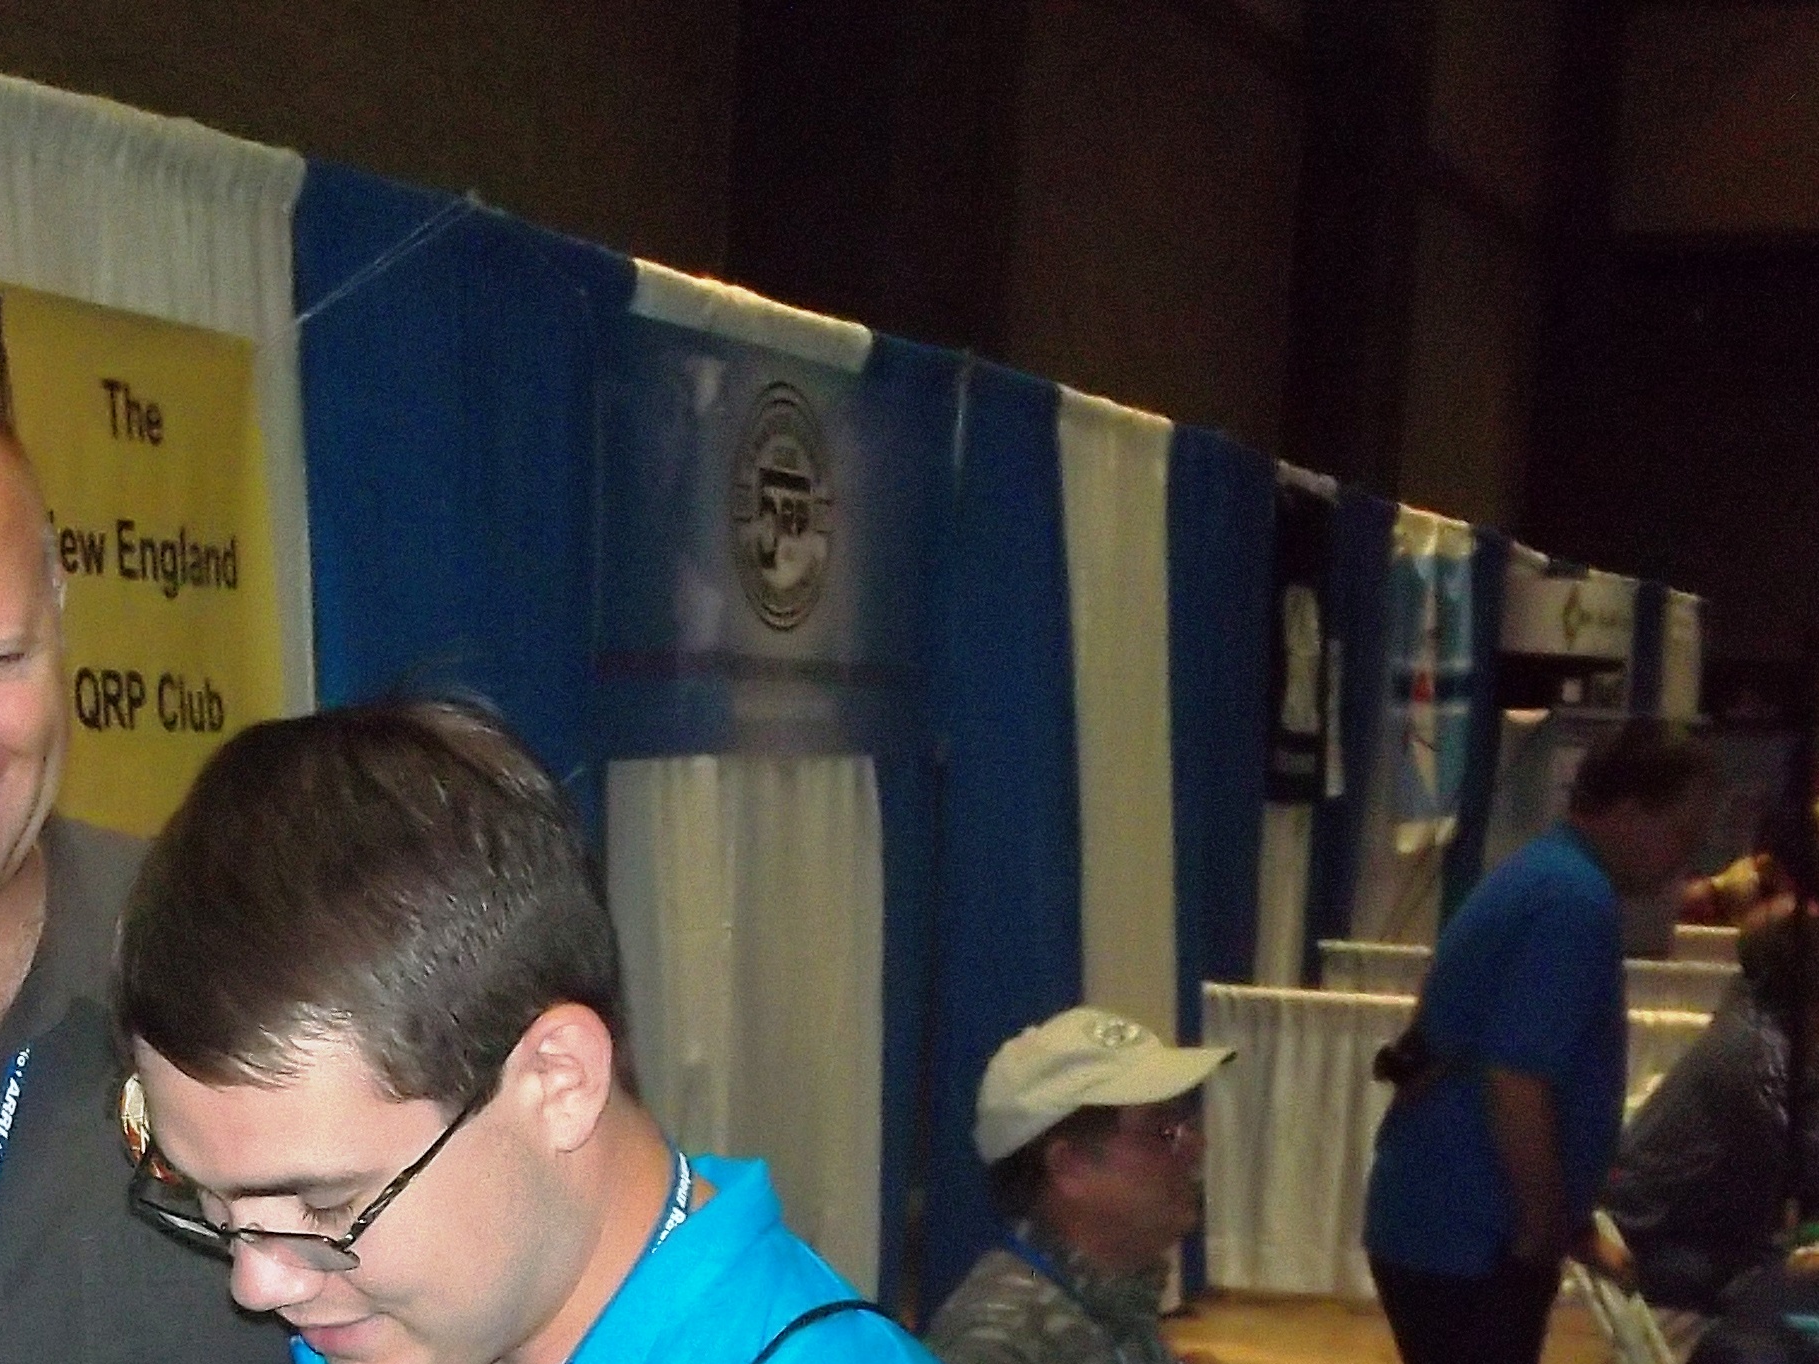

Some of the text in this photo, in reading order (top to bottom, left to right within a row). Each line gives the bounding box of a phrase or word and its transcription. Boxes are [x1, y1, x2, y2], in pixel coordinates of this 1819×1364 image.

[100, 378, 164, 445] The
[48, 509, 238, 600] ew England
[74, 666, 225, 733] QRP Club
